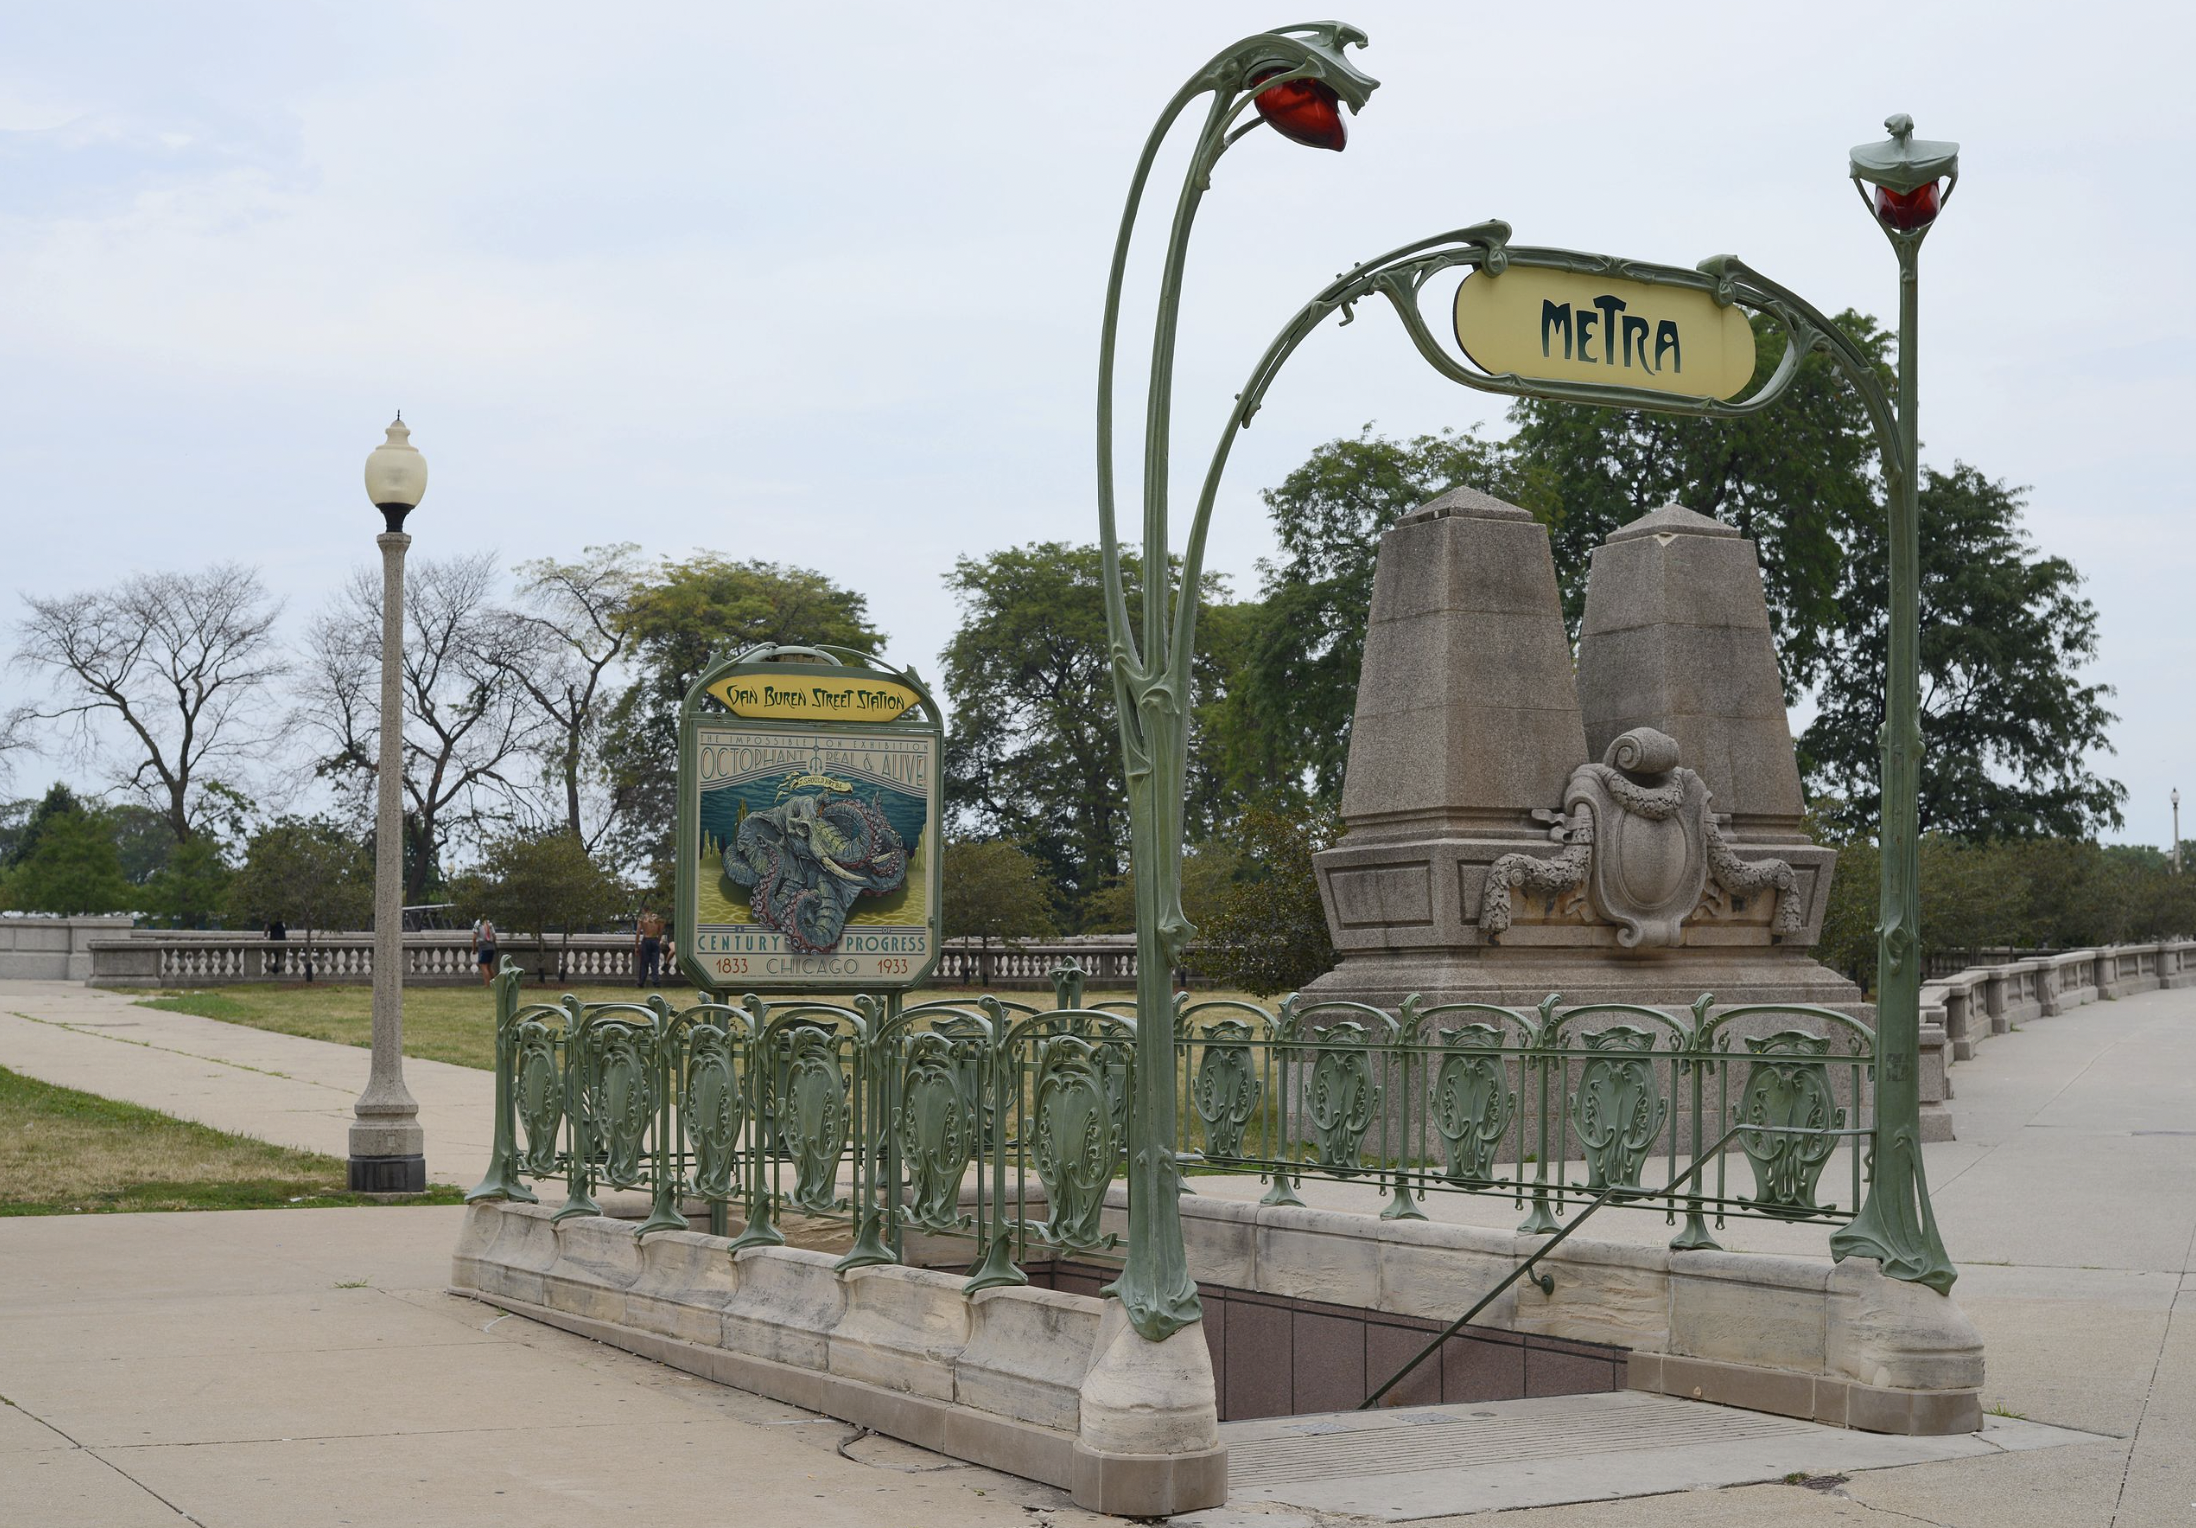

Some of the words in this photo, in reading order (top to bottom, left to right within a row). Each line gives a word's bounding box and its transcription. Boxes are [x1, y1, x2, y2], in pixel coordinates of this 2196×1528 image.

[1541, 294, 1681, 375] METRA
[726, 684, 758, 707] VAN
[764, 686, 806, 709] BUREN
[812, 688, 854, 711] STREET
[857, 690, 905, 712] STATION
[700, 734, 720, 744] THE
[729, 736, 807, 747] IMPOSSIBLE
[826, 739, 842, 749] ON
[853, 741, 928, 752] EXHIBITION
[701, 746, 805, 780] OCTOPHANT
[826, 751, 857, 767] REAL
[863, 753, 873, 771] &
[697, 935, 781, 951] CENTURY
[846, 936, 926, 952] PROGRESS
[716, 958, 748, 974] 1833
[766, 958, 859, 975] CHICAGO
[877, 958, 908, 975] 1933
